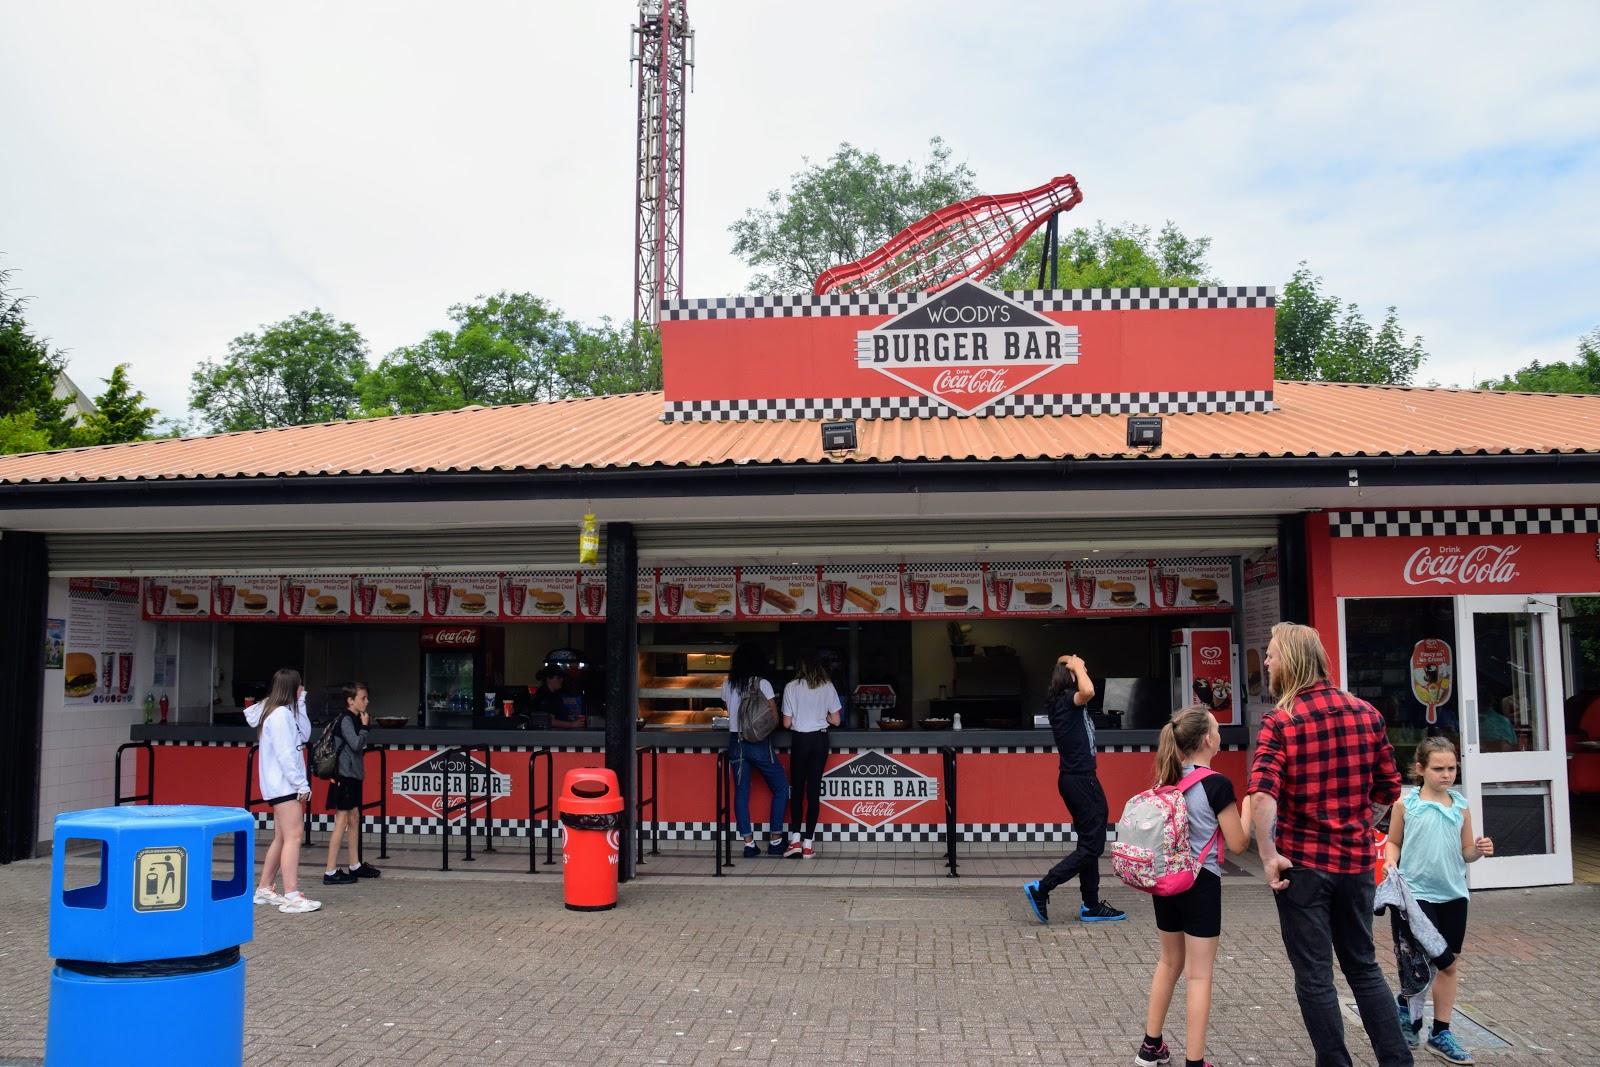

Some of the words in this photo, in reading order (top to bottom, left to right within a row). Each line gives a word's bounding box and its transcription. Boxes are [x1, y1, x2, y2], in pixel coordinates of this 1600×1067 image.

[927, 305, 1010, 323] WOODY'S
[872, 332, 988, 362] BURGER
[1004, 330, 1062, 360] BAR
[932, 368, 1009, 394] Coca-Cola
[1404, 545, 1521, 585] Coca-Cola
[436, 629, 477, 644] Coca-Cola
[849, 764, 898, 775] WOODY'S
[820, 780, 885, 797] BURGER
[894, 780, 928, 797] BAR
[852, 802, 896, 816] Coca-Cola
